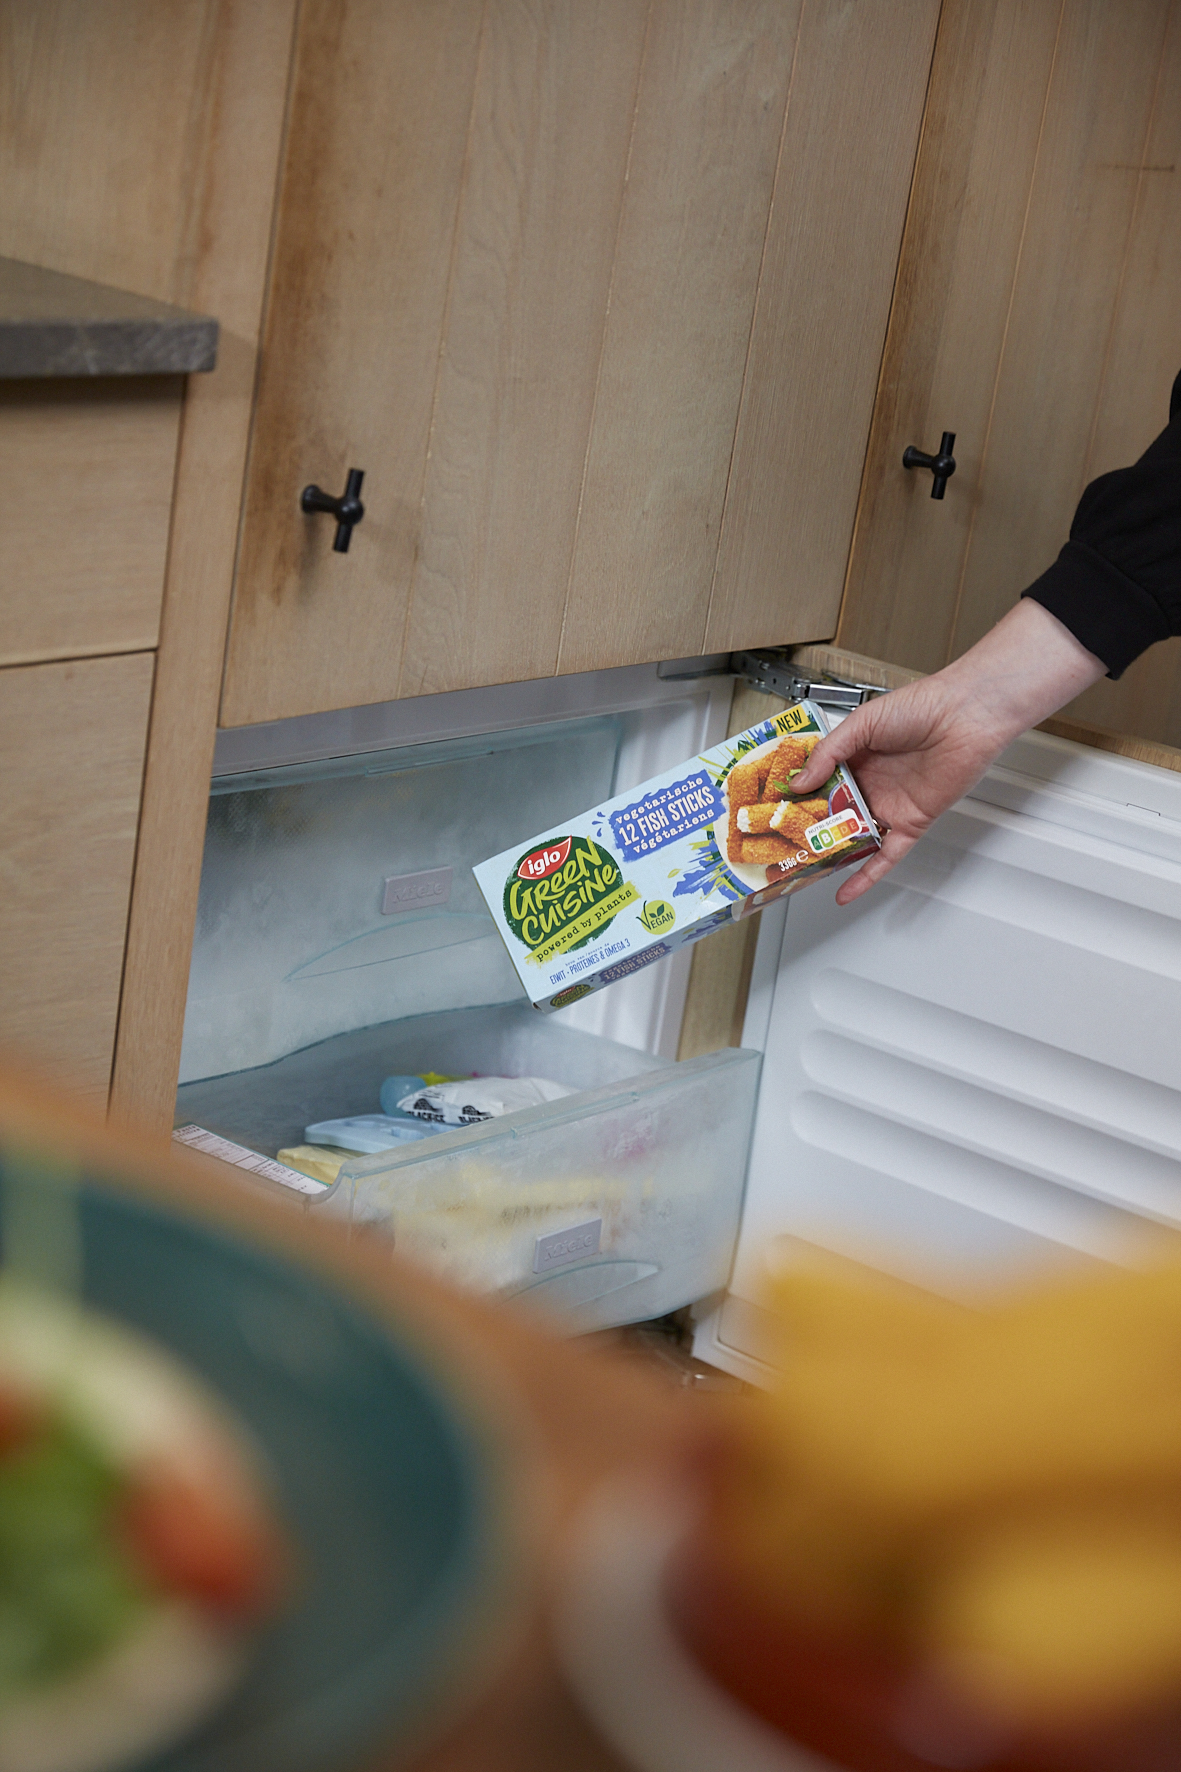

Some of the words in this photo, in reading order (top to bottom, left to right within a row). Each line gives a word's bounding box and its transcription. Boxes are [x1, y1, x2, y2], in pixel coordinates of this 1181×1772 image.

[776, 710, 802, 733] NEW
[615, 776, 704, 825] vegetarische
[618, 823, 640, 847] 12
[638, 806, 670, 837] FISH
[669, 785, 715, 822] STICKS
[633, 808, 715, 854] végétariens
[808, 815, 843, 835] NUTRI-SCORE
[527, 850, 561, 876] iglo
[393, 881, 444, 904] Miele
[536, 927, 580, 963] powered
[580, 917, 593, 929] by
[594, 889, 633, 920] plants
[636, 900, 675, 931] VEGAN
[569, 953, 601, 975] PROTEINES
[604, 941, 626, 957] OMEGA
[625, 938, 631, 947] 3
[544, 1233, 593, 1261] Miele
